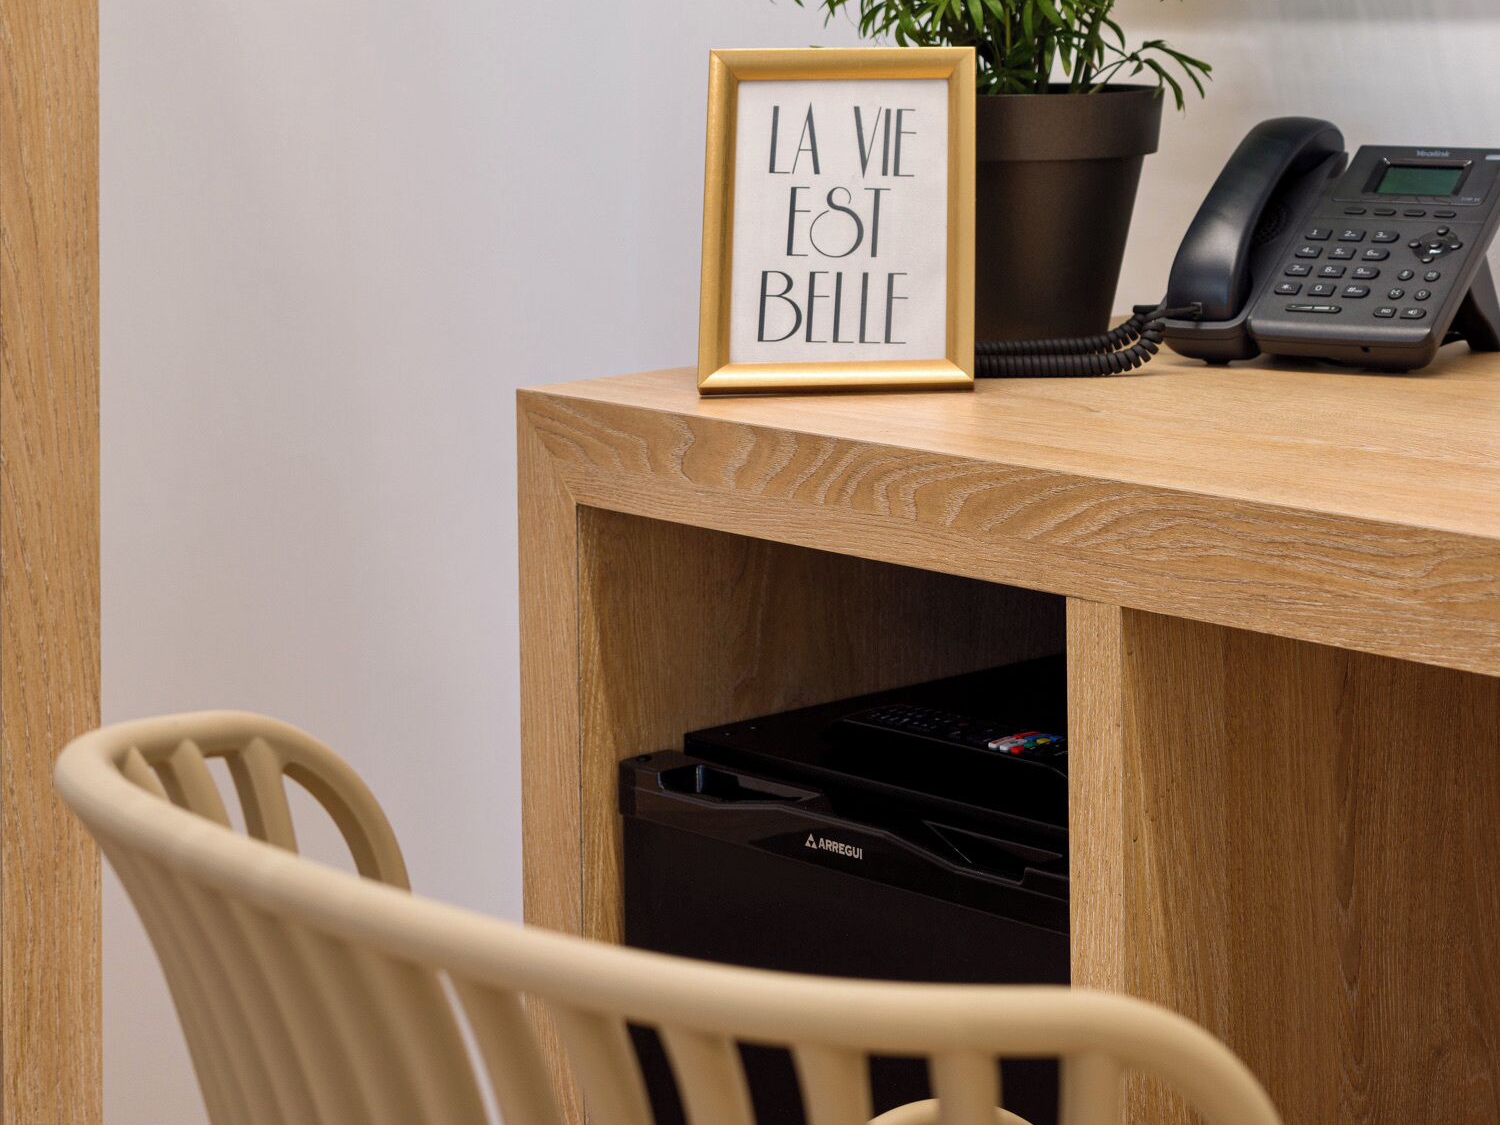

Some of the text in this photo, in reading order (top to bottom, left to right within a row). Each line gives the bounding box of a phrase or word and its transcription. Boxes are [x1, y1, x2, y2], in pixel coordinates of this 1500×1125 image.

[768, 101, 917, 178] LA VIE
[786, 186, 892, 258] EST
[757, 270, 909, 345] BELLE
[818, 837, 863, 860] ARREGUI
